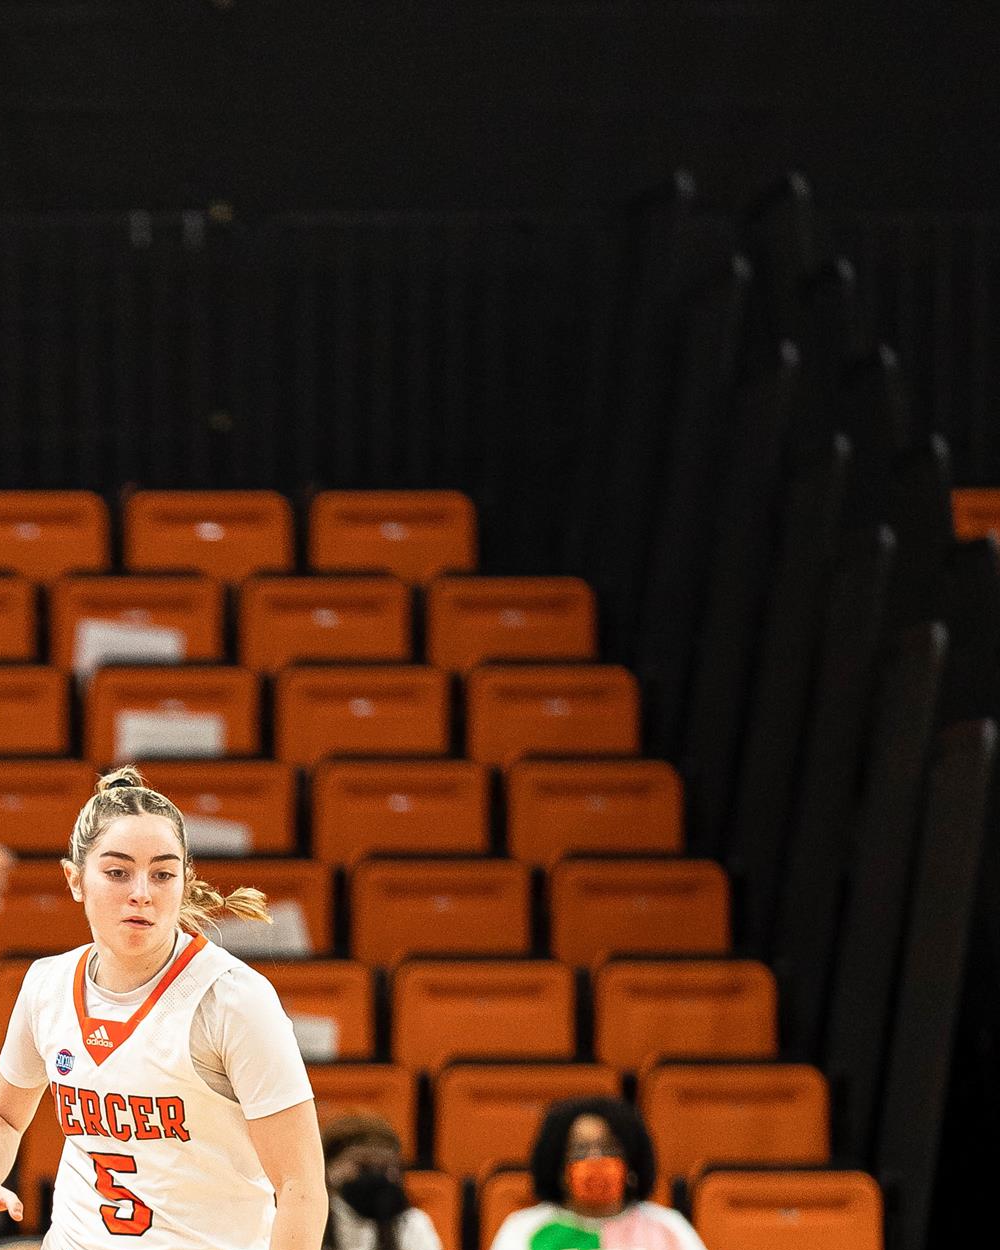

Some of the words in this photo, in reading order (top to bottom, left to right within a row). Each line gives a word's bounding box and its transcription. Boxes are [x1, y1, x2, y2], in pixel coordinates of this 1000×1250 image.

[86, 1037, 113, 1048] adidas
[51, 1081, 191, 1142] ERCER
[87, 1151, 154, 1236] 5
